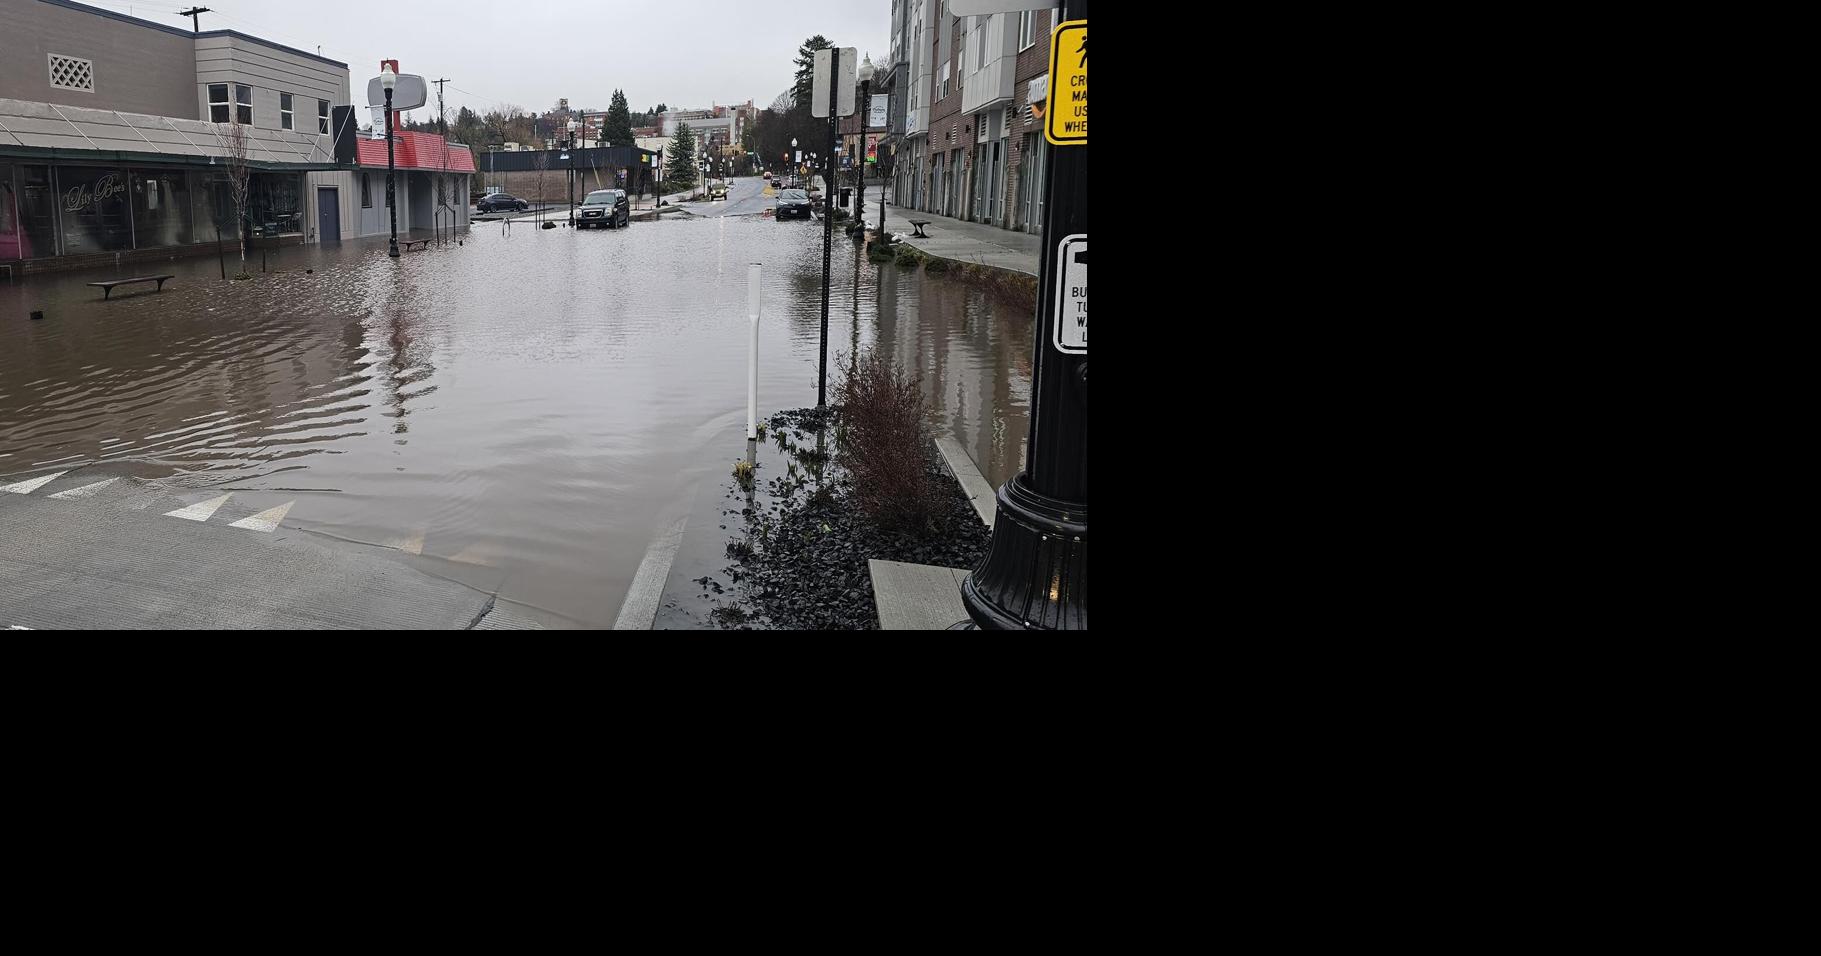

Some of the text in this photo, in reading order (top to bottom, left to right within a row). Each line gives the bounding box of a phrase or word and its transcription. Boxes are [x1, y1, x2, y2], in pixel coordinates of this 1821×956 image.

[1071, 75, 1087, 87] CR
[1064, 121, 1087, 133] WHE
[64, 173, 125, 212] Lily Bee's
[1072, 287, 1087, 297] BU
